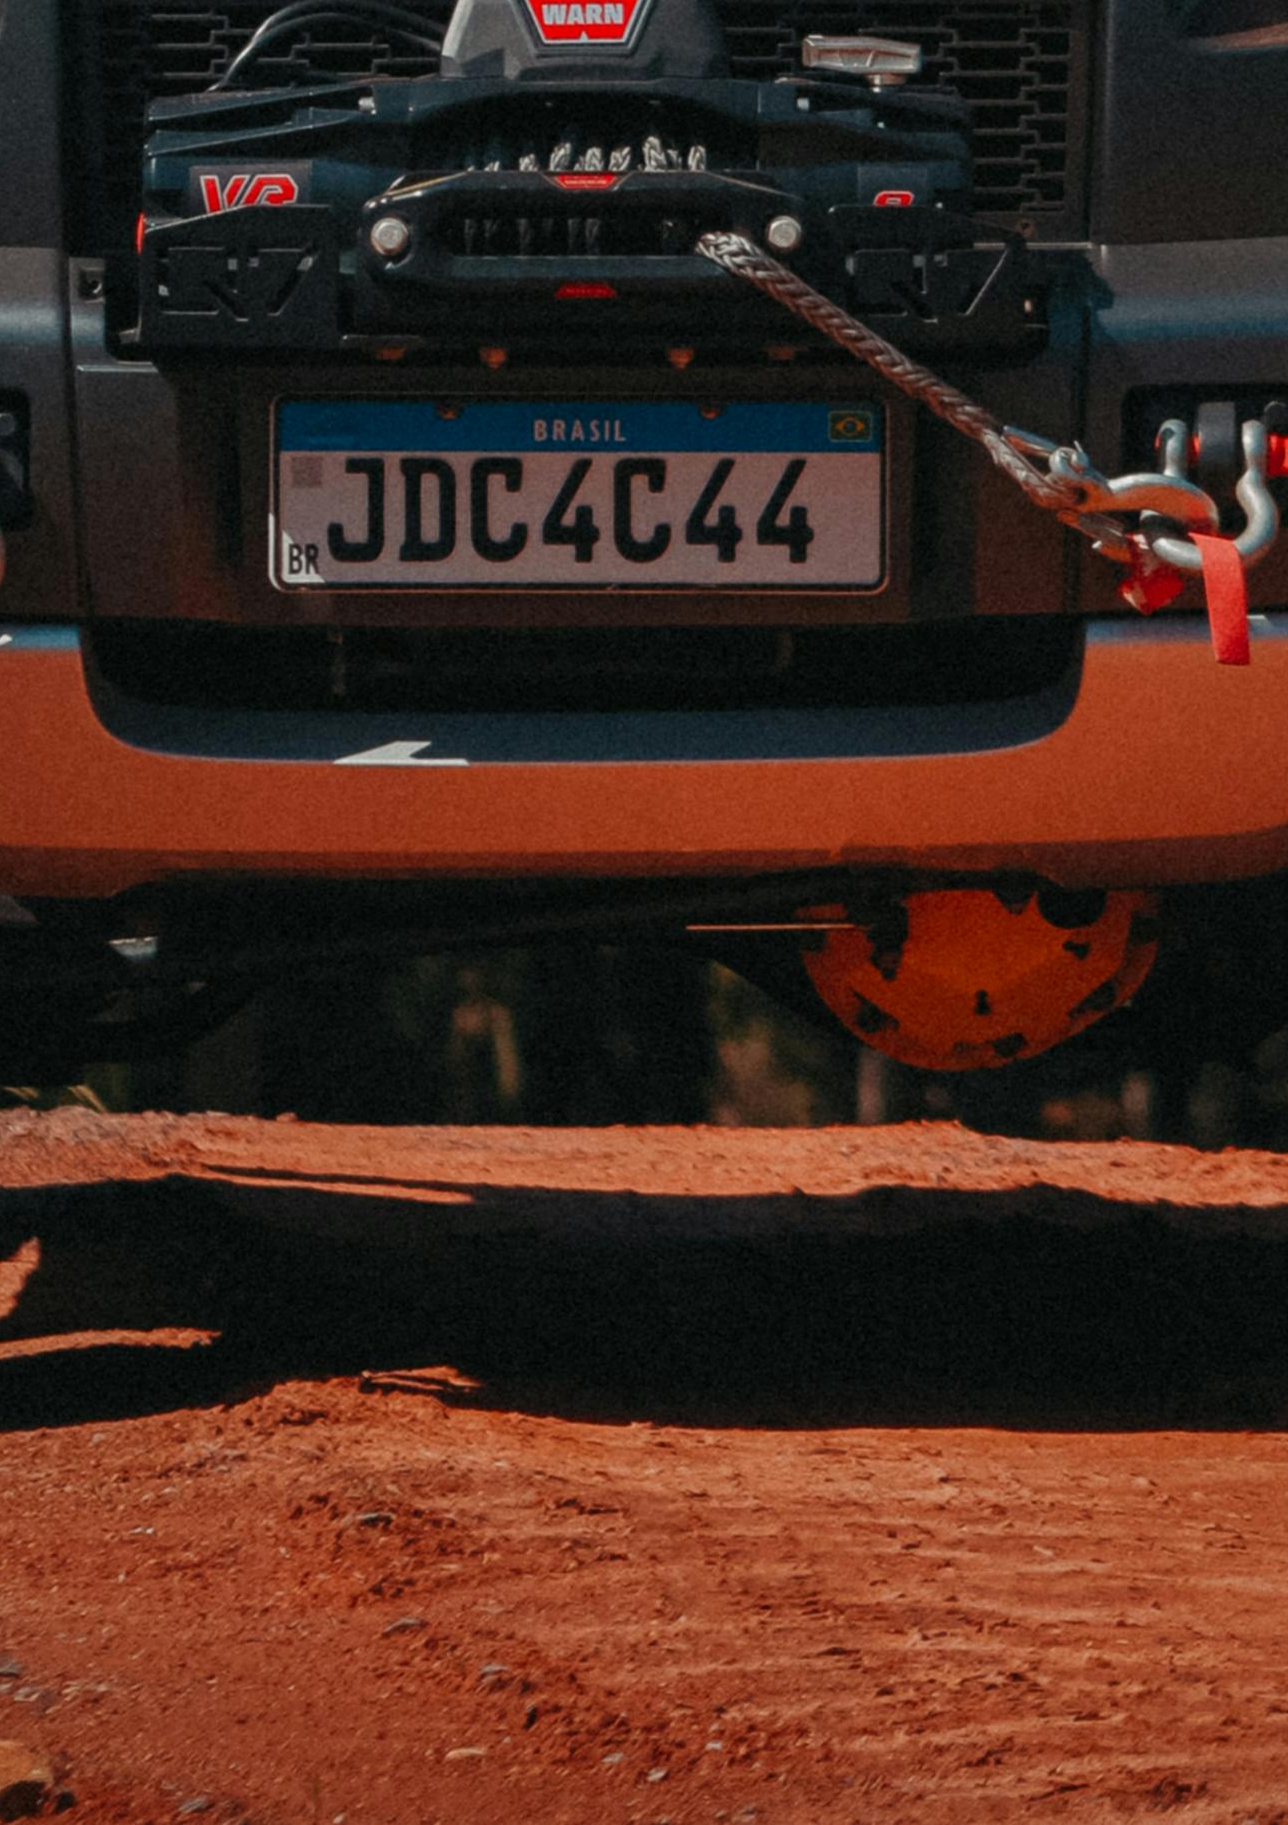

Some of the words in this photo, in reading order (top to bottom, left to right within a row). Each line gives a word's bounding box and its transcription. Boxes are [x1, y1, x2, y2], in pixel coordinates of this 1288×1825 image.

[541, 3, 624, 25] WARN
[533, 418, 627, 443] BRASIL
[327, 457, 815, 563] JDC4C44
[288, 543, 320, 575] BR
